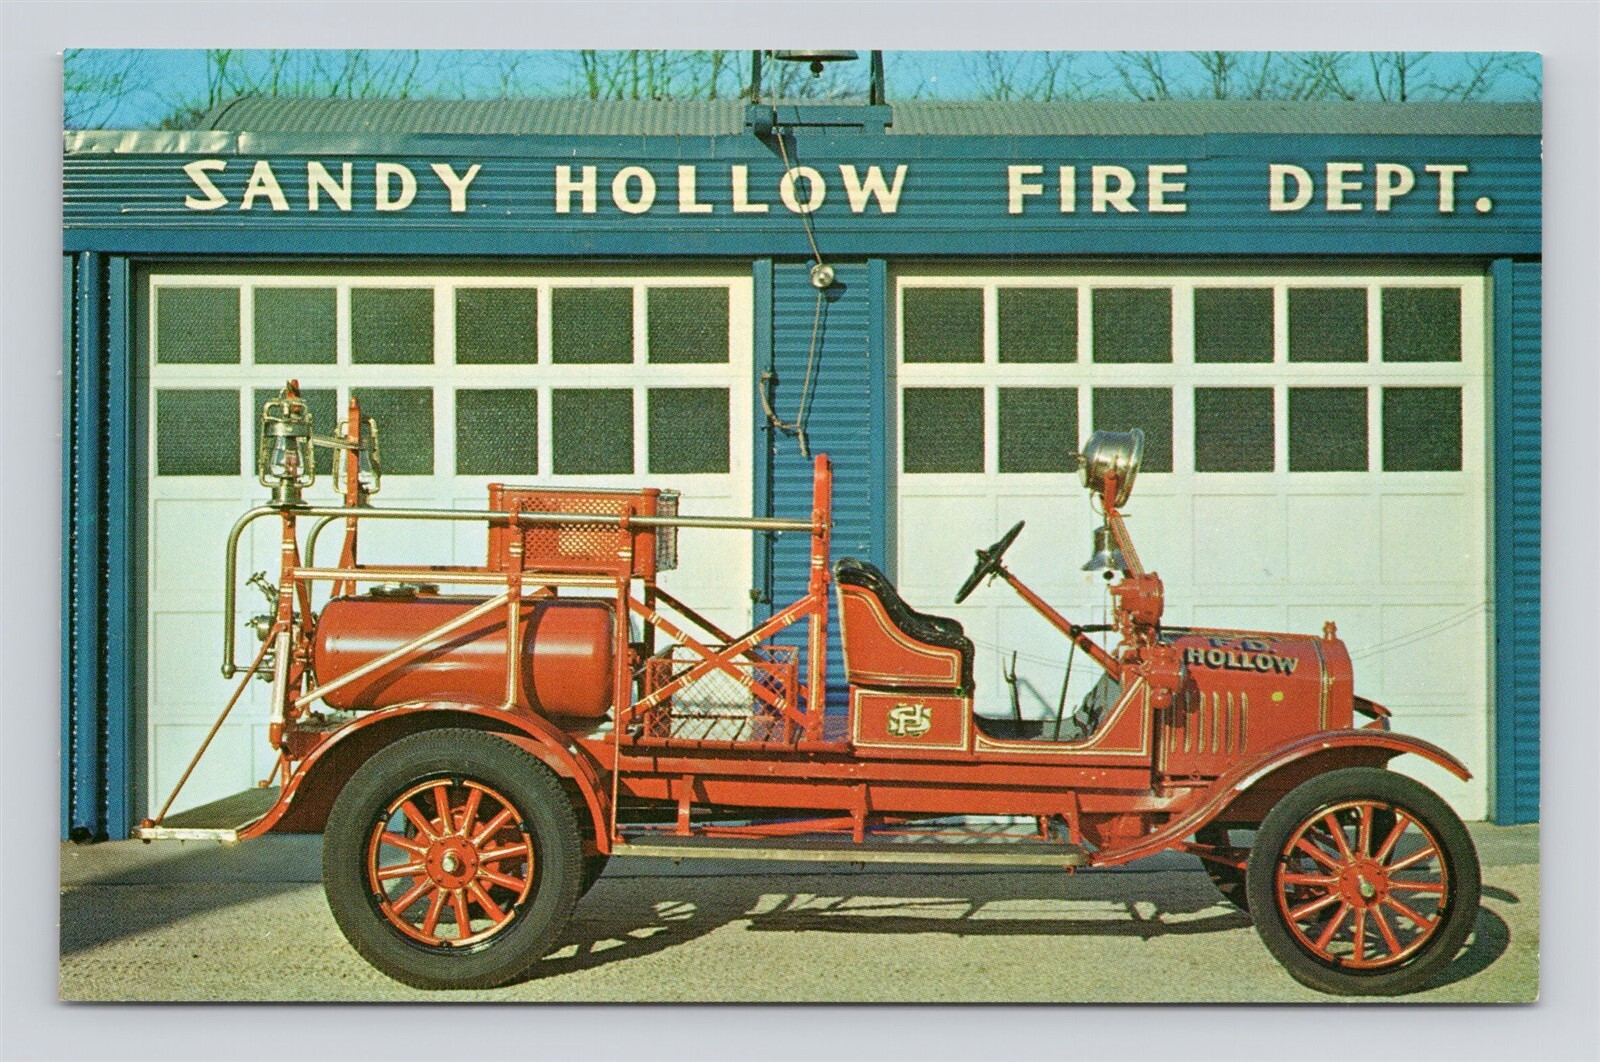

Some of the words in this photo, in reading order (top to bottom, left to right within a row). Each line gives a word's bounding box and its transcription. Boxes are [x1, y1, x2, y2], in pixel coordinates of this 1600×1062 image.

[183, 159, 482, 213] SANDY
[555, 164, 908, 214] HOLLOW
[1007, 164, 1188, 214] FIRE
[1268, 162, 1493, 214] DEPT.
[1184, 647, 1299, 676] HOLLOW
